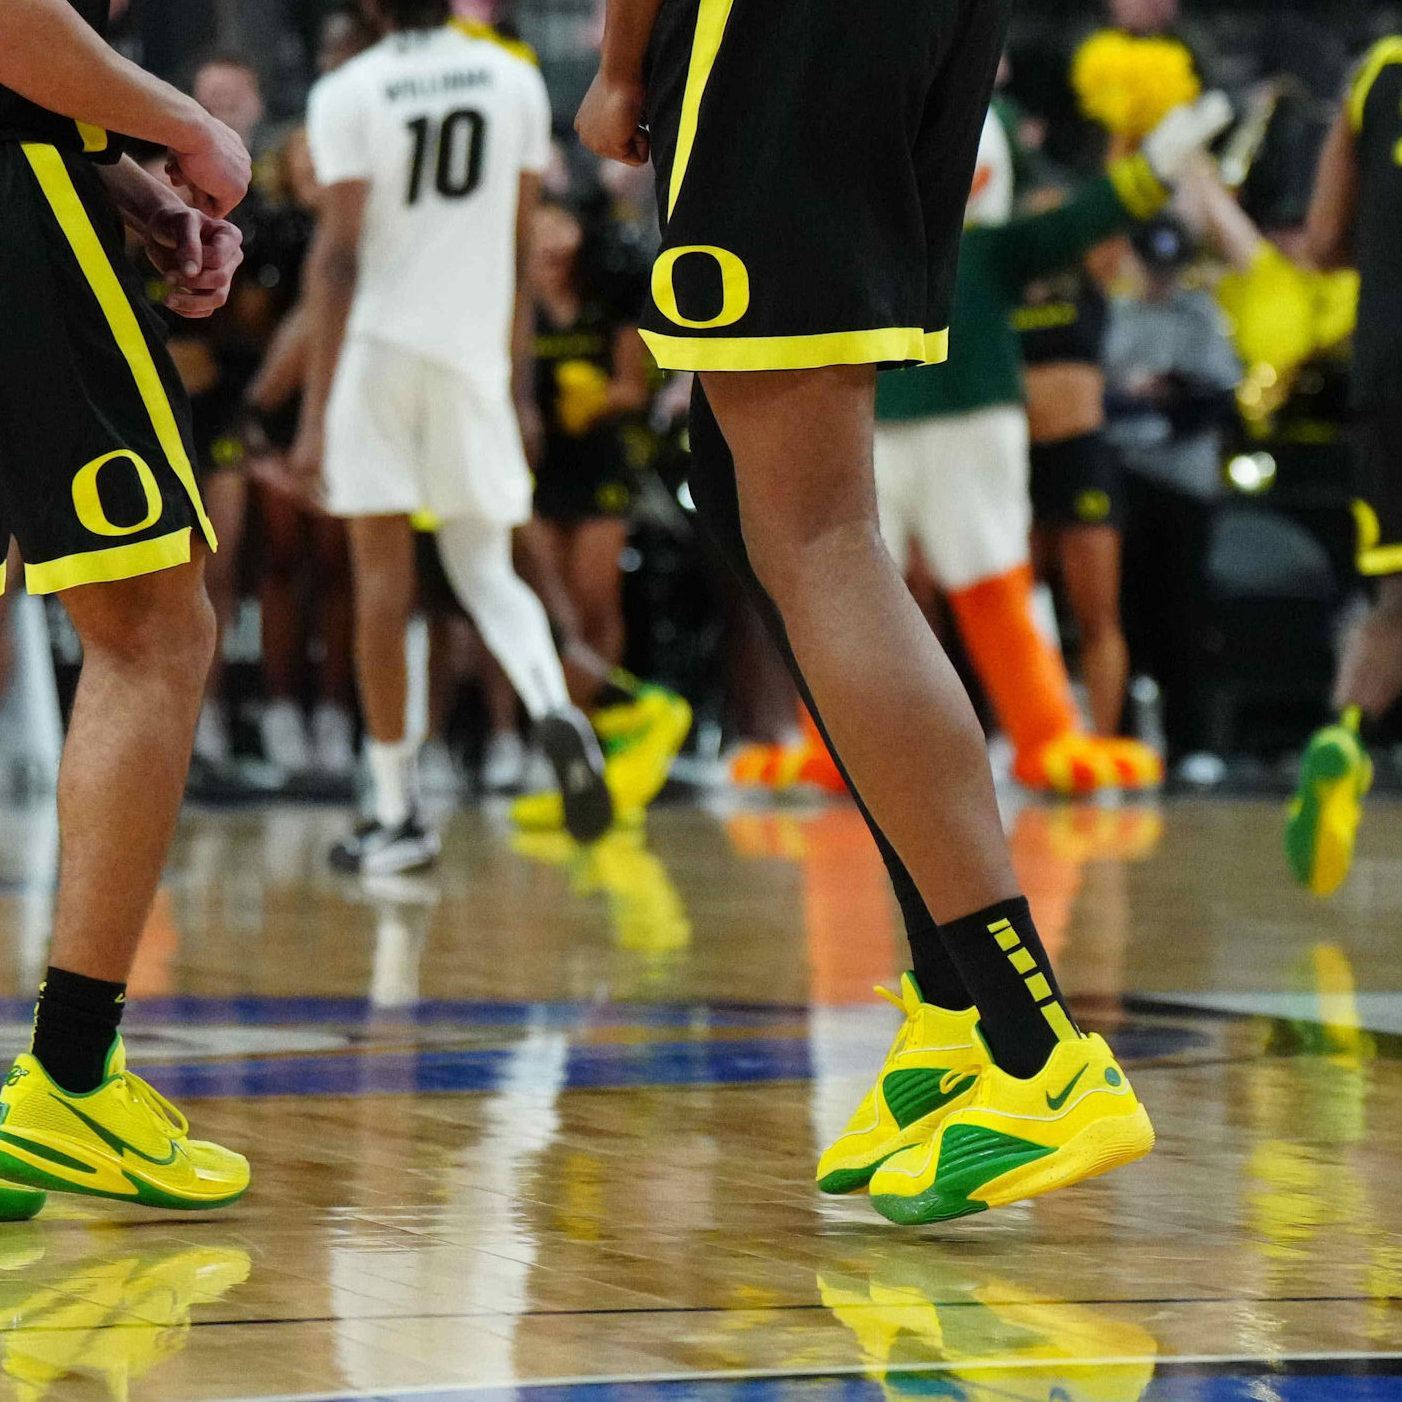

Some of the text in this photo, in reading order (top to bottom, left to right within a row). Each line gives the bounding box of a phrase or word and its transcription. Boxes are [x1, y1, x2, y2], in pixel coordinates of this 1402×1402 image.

[407, 109, 486, 205] 10
[651, 245, 750, 329] O
[71, 449, 163, 536] O
